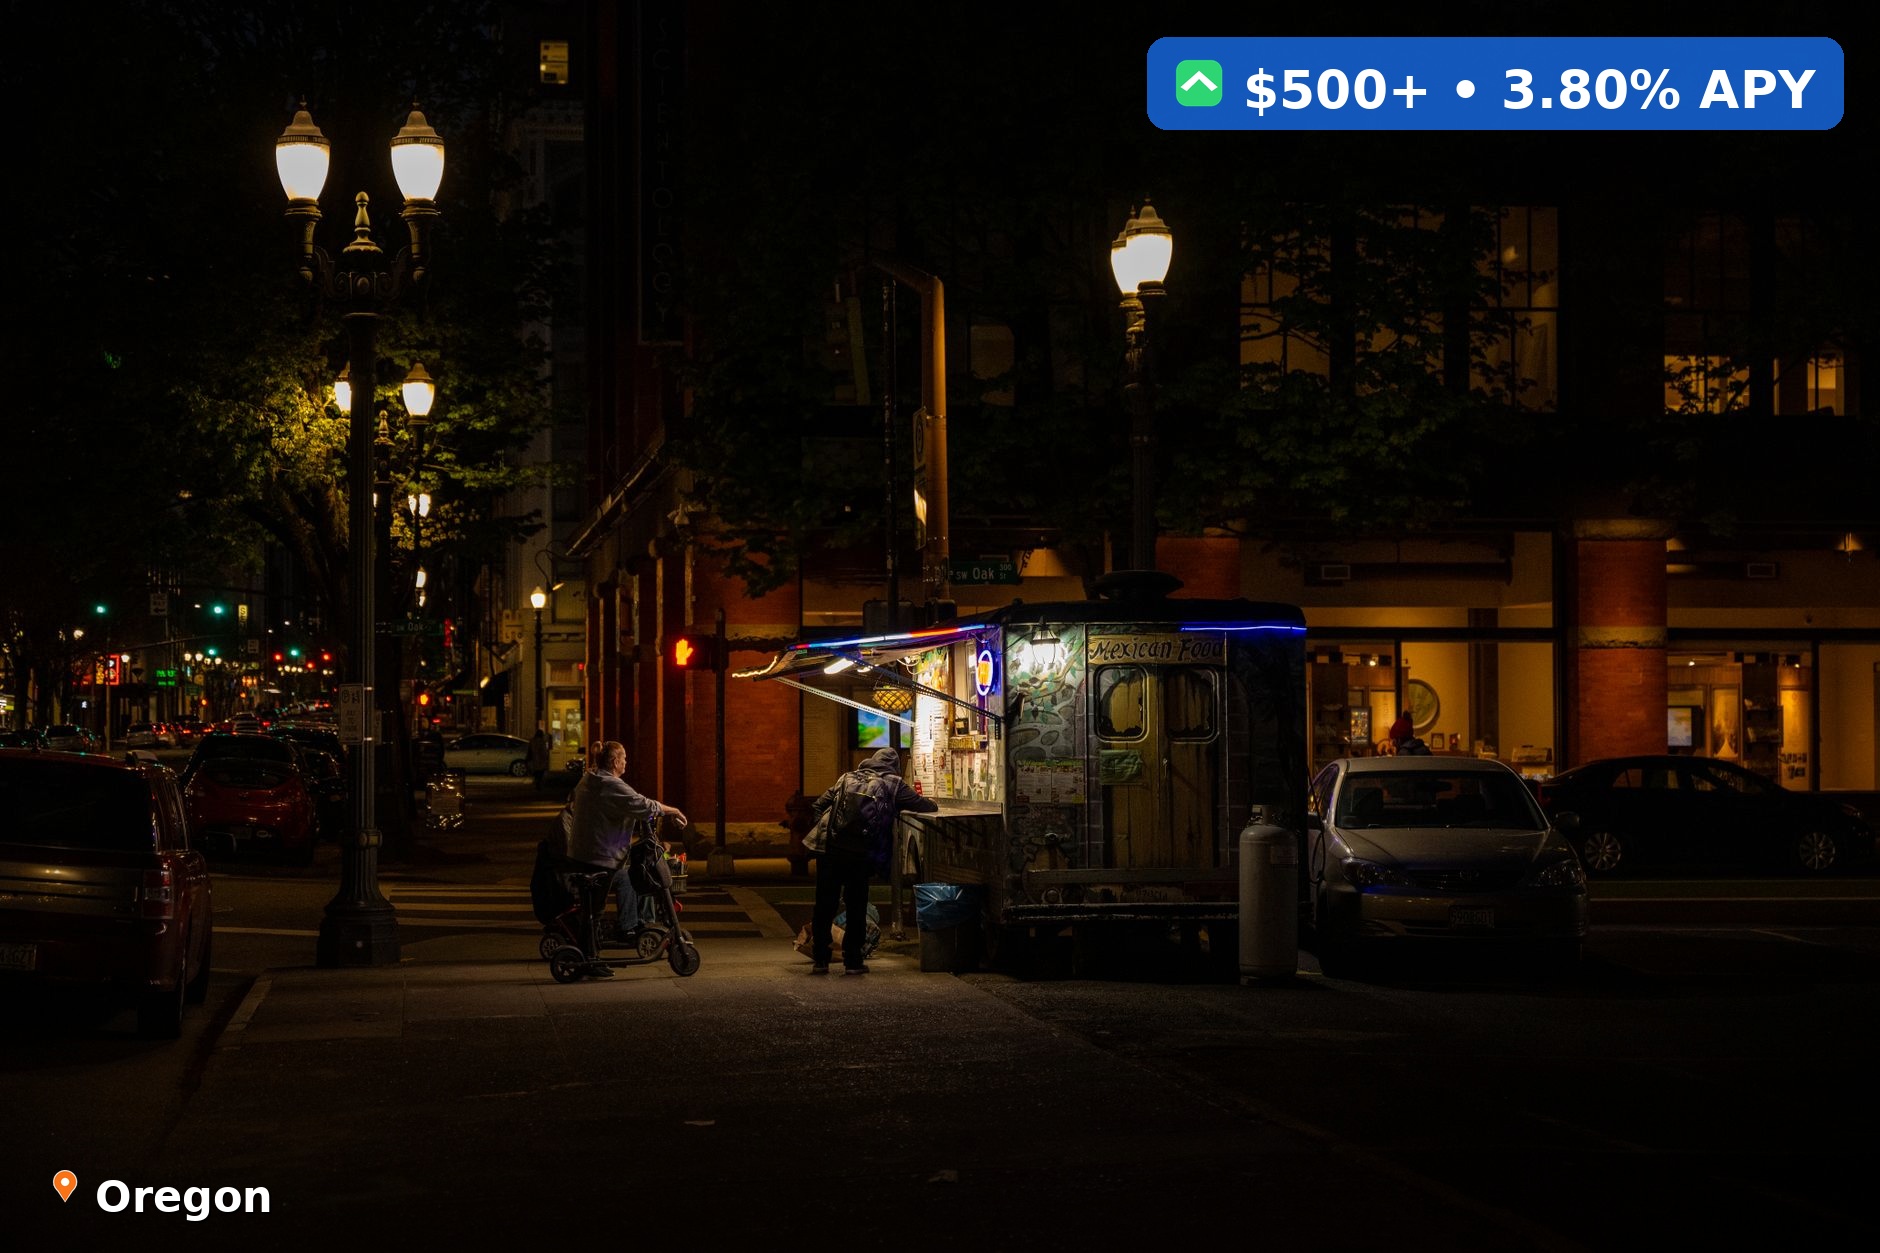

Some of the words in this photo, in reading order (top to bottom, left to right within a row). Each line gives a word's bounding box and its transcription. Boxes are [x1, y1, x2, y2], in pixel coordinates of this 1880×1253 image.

[972, 567, 995, 580] Oak
[1089, 636, 1173, 661] Mexican
[1177, 637, 1225, 661] Food
